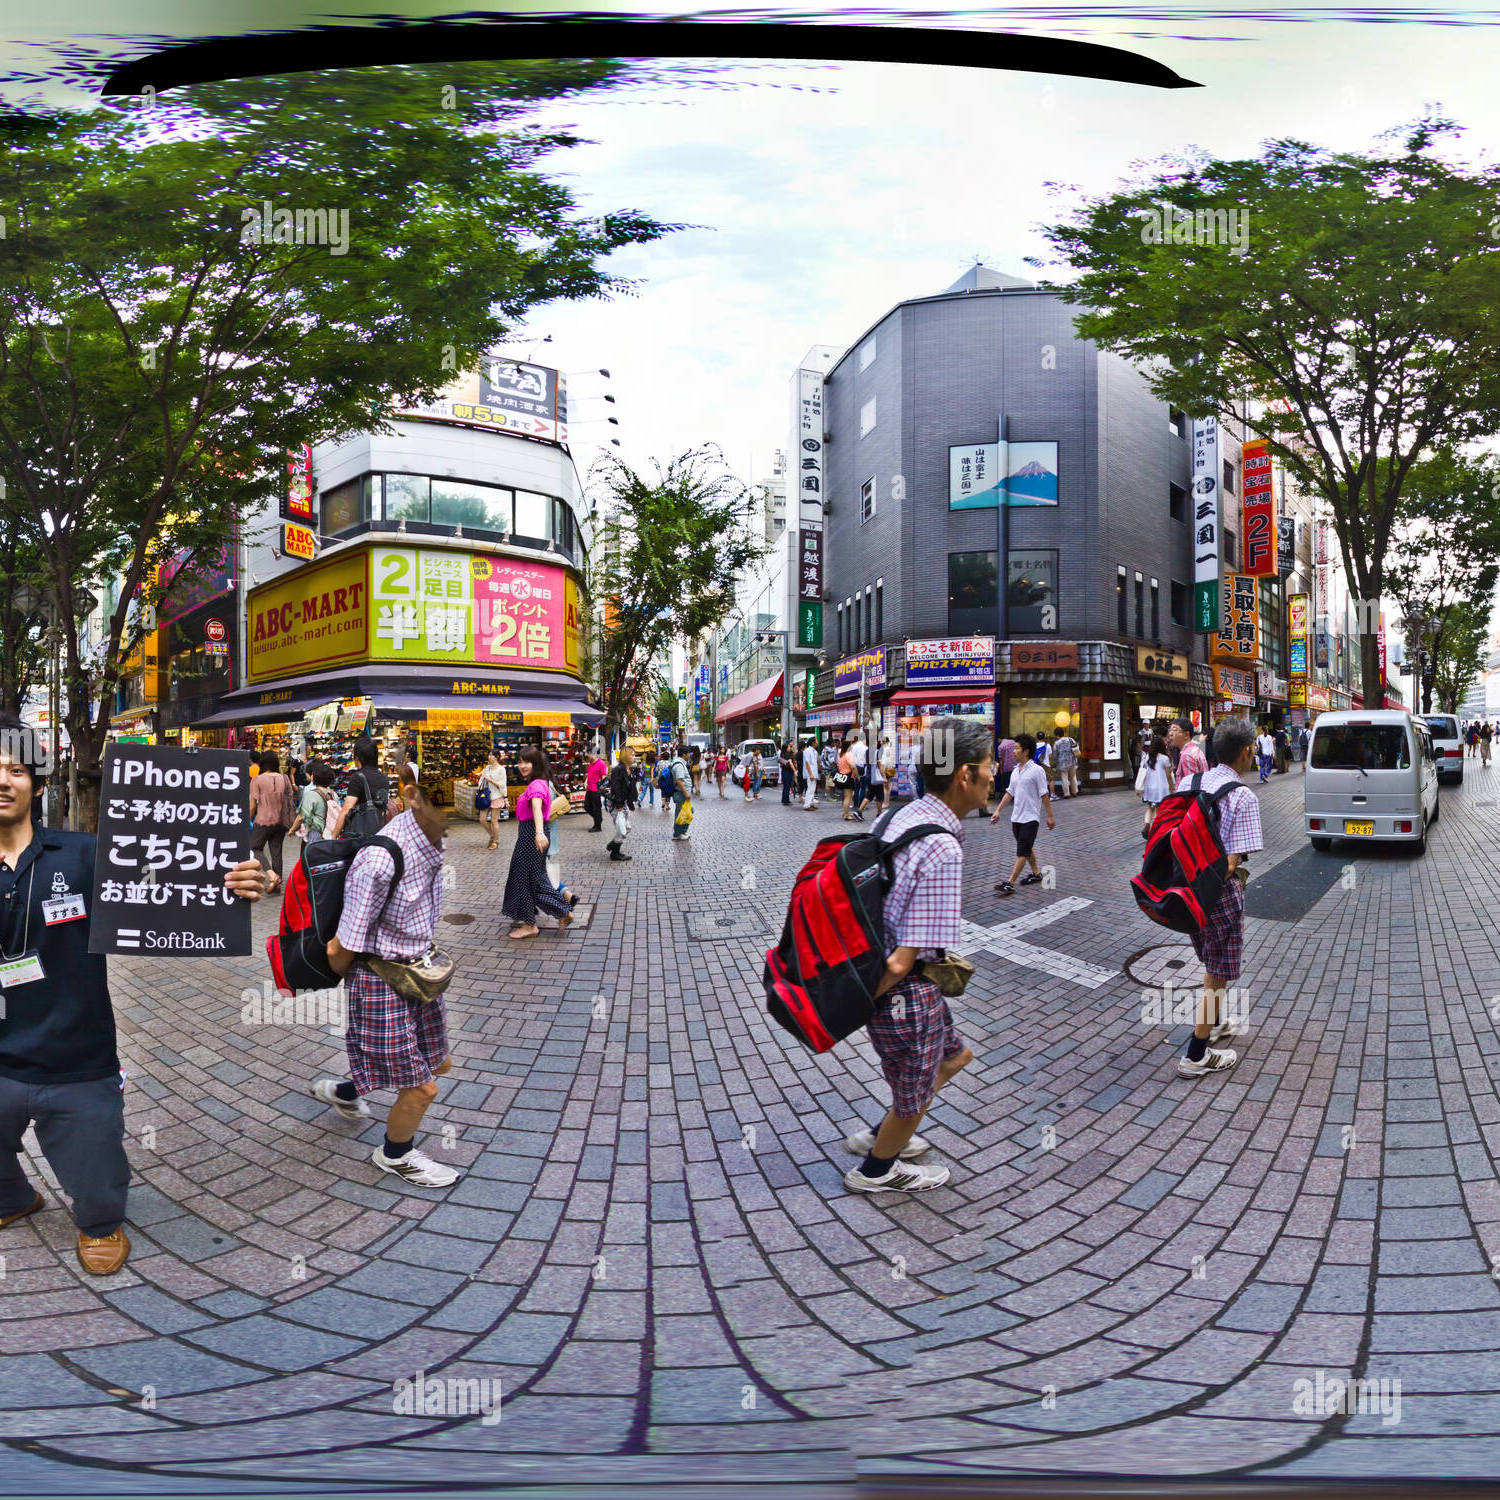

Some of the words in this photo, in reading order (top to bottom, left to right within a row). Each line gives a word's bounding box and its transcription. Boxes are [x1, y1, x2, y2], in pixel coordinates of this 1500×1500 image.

[499, 368, 542, 395] 牛角
[975, 448, 985, 480] 山は富士
[1245, 455, 1270, 470] 時計
[801, 457, 821, 507] 三国一
[961, 457, 972, 495] 味は三国一
[1245, 473, 1271, 489] 宝石
[1245, 491, 1271, 508] 売場
[287, 527, 313, 546] ABC
[1195, 501, 1217, 564] 三国一
[1248, 513, 1270, 569] 2F
[286, 541, 313, 556] MART
[424, 557, 463, 568] ビジネス
[380, 554, 410, 594] 2
[424, 579, 463, 597] 足目
[424, 568, 463, 578] シューズ
[497, 567, 546, 579] レディースデー
[801, 551, 820, 598] 越後屋
[254, 582, 363, 642] ABC-MART
[493, 600, 548, 618] ポイント
[1234, 576, 1256, 655] 買取と質は
[254, 618, 363, 655] www.abc-mart.com
[376, 604, 468, 653] 半額
[490, 615, 551, 660] 2倍
[909, 640, 991, 655] ようこそ新宿へ!
[764, 656, 781, 664] ALTA
[909, 659, 949, 670] アクセス
[951, 658, 991, 668] チケット
[968, 667, 991, 675] 新宿店
[452, 681, 511, 696] ABC-MART
[1219, 667, 1254, 695] 大黒屋
[260, 690, 293, 705] ABC-MART
[1215, 701, 1233, 712] 金券
[483, 711, 521, 721] ABC-MART
[1107, 722, 1117, 755] 三国一
[112, 758, 240, 790] iPhone5
[107, 799, 242, 825] ご予約の方は
[108, 834, 239, 871] こちらに
[51, 906, 80, 920] すずき
[145, 930, 226, 949] SoftBank
